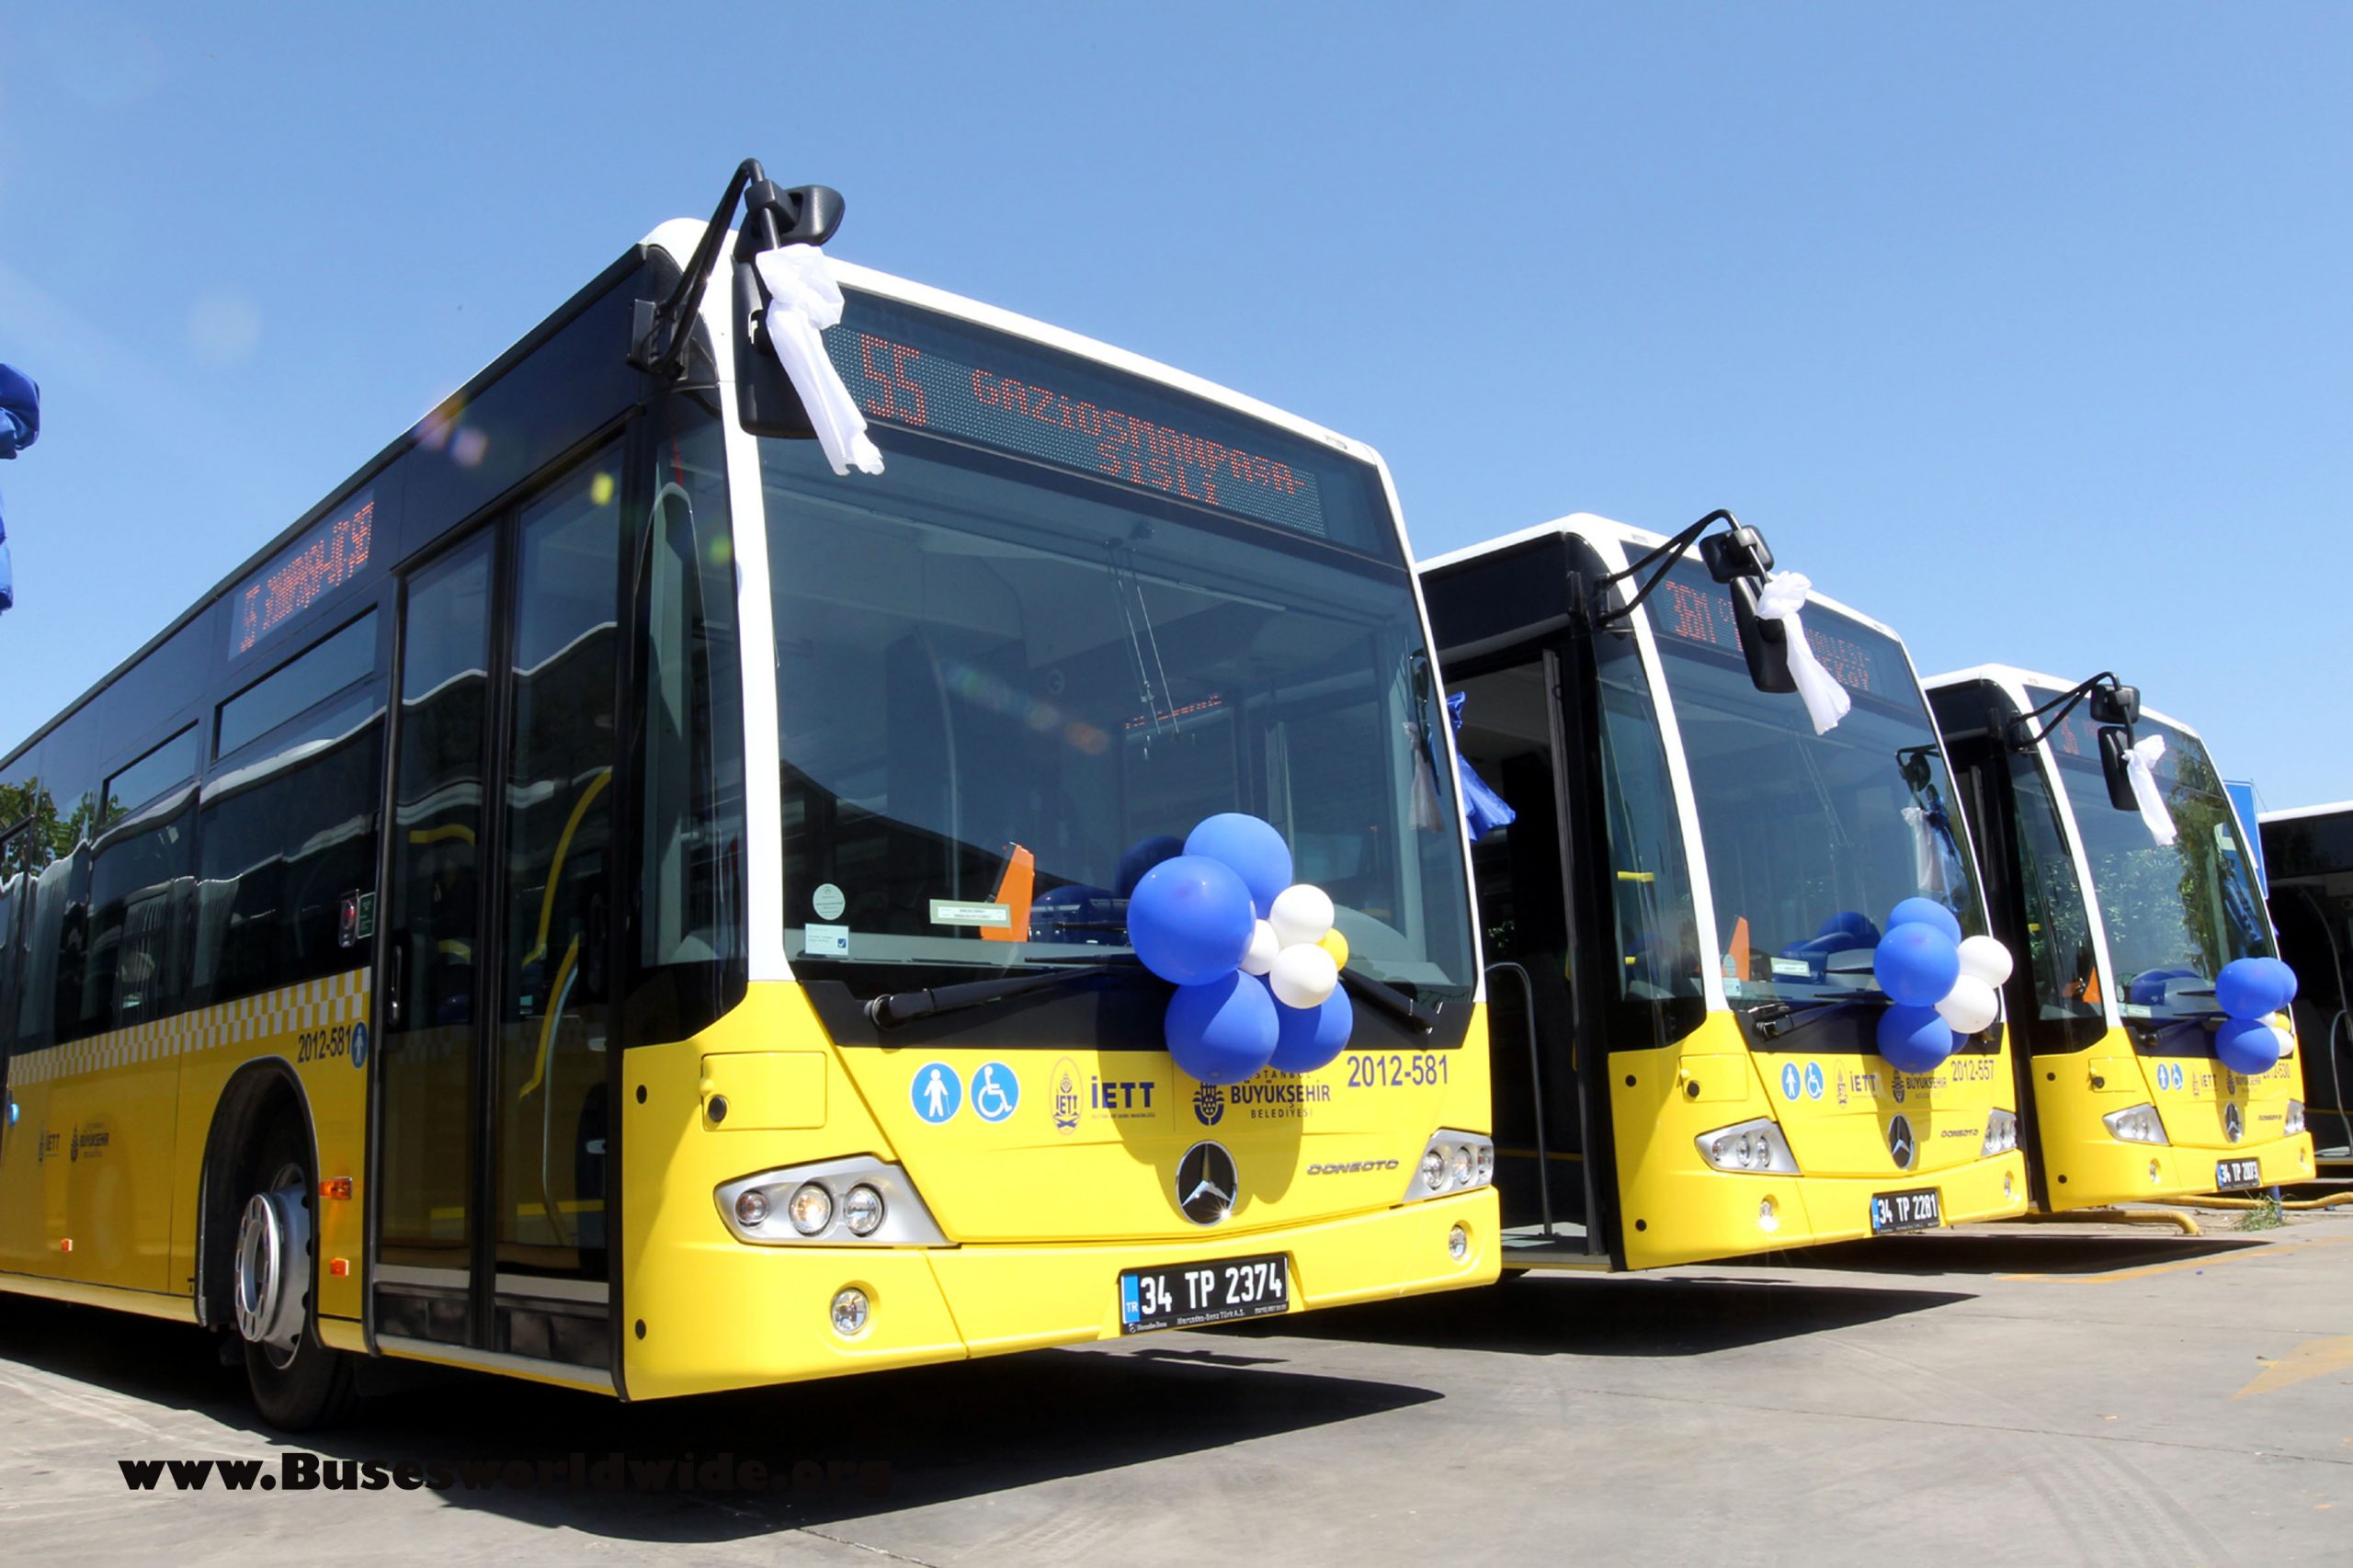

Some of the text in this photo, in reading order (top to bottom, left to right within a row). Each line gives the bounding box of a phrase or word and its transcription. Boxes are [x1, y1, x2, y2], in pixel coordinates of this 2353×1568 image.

[860, 333, 926, 427] 55
[298, 1024, 351, 1063] 2012-581
[1347, 1054, 1449, 1087] 2012-581
[1950, 1059, 1995, 1082] 2012-557
[1231, 1079, 1331, 1108] BÜYÜKŞEHİR
[2221, 1164, 2231, 1183] 34
[2232, 1163, 2241, 1181] TP
[1878, 1199, 1893, 1224] 34
[1896, 1197, 1910, 1221] TP
[1140, 1263, 1283, 1315] 34 TP 2374
[1126, 1301, 1139, 1313] TR
